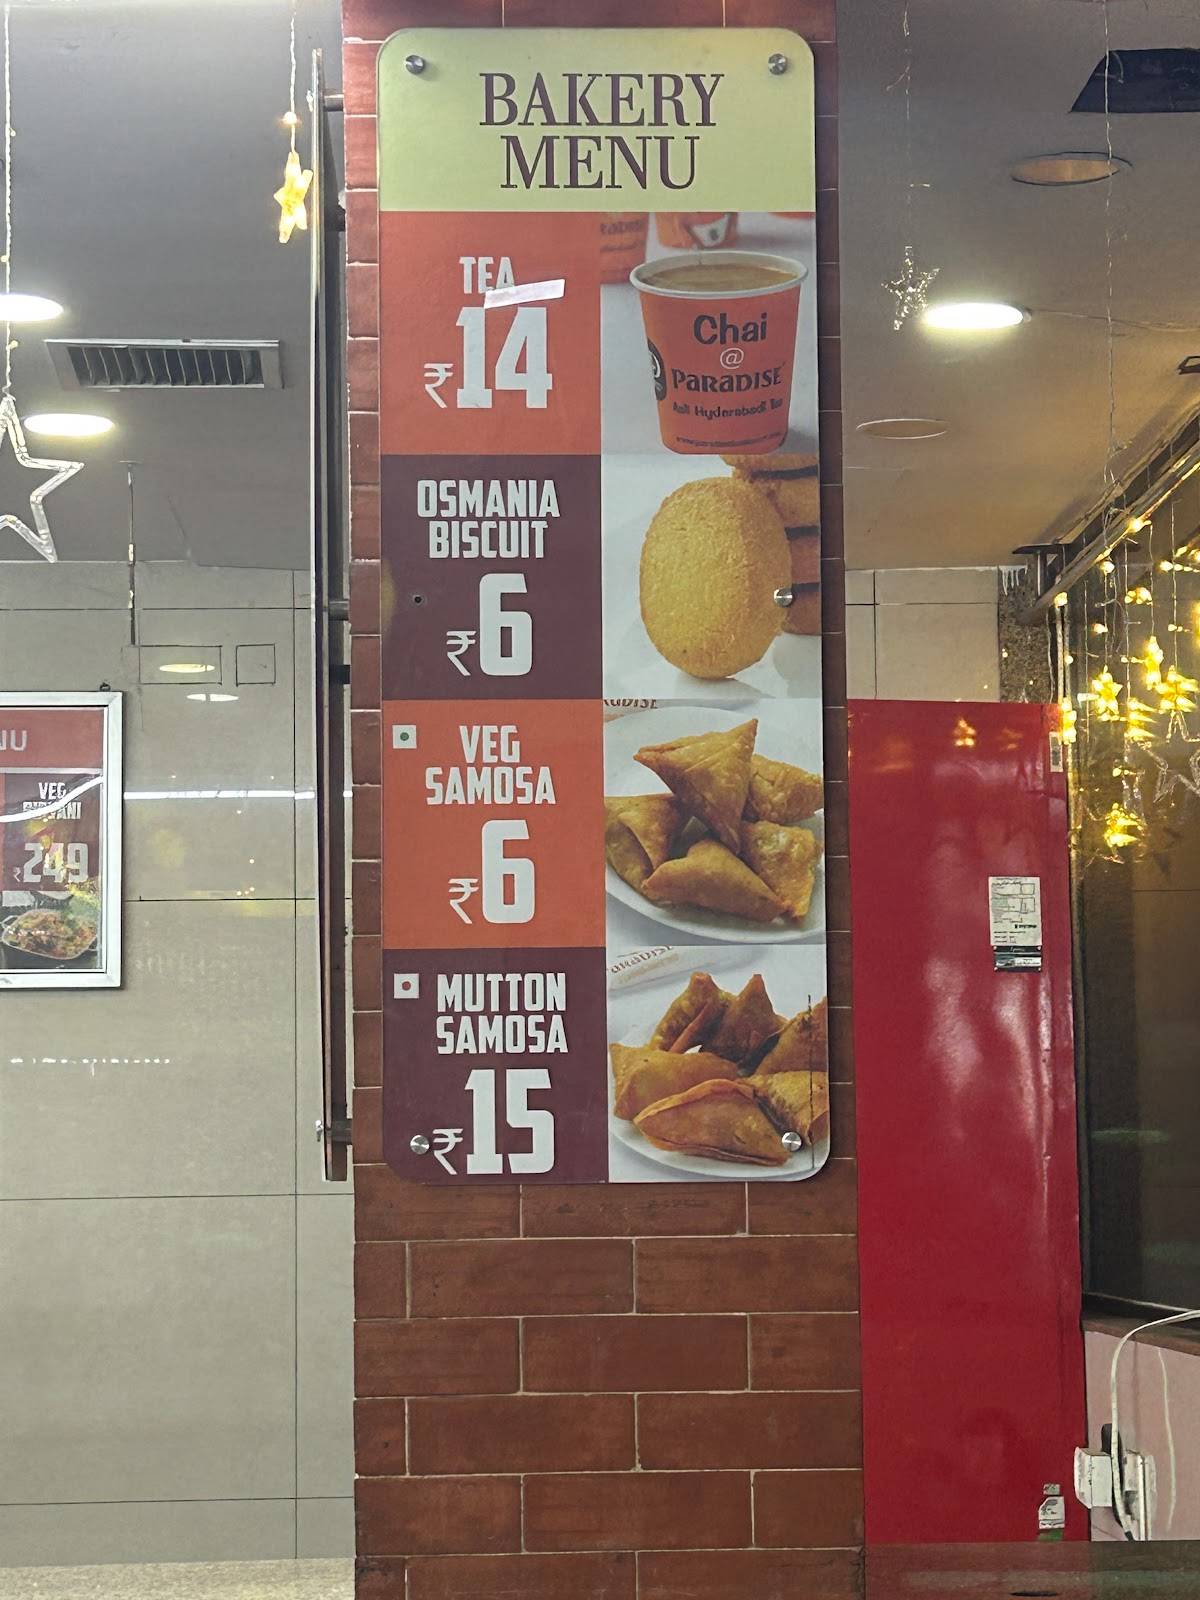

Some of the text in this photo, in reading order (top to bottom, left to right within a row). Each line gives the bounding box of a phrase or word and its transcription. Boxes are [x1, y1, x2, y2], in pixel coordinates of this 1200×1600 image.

[479, 72, 725, 127] BAKERY
[499, 135, 700, 190] MENU
[459, 256, 515, 294] TEA
[693, 312, 767, 345] Chai
[719, 347, 744, 370] @
[417, 479, 560, 518] OSMANIA
[429, 520, 548, 559] BISCUIT
[446, 573, 533, 677] ₹6
[459, 725, 521, 764] VEG
[425, 766, 556, 806] SAMOSA
[448, 819, 536, 925] ₹6
[437, 972, 567, 1013] MUTTON
[436, 1014, 569, 1055] SAMOSA
[432, 1068, 556, 1175] ₹15
